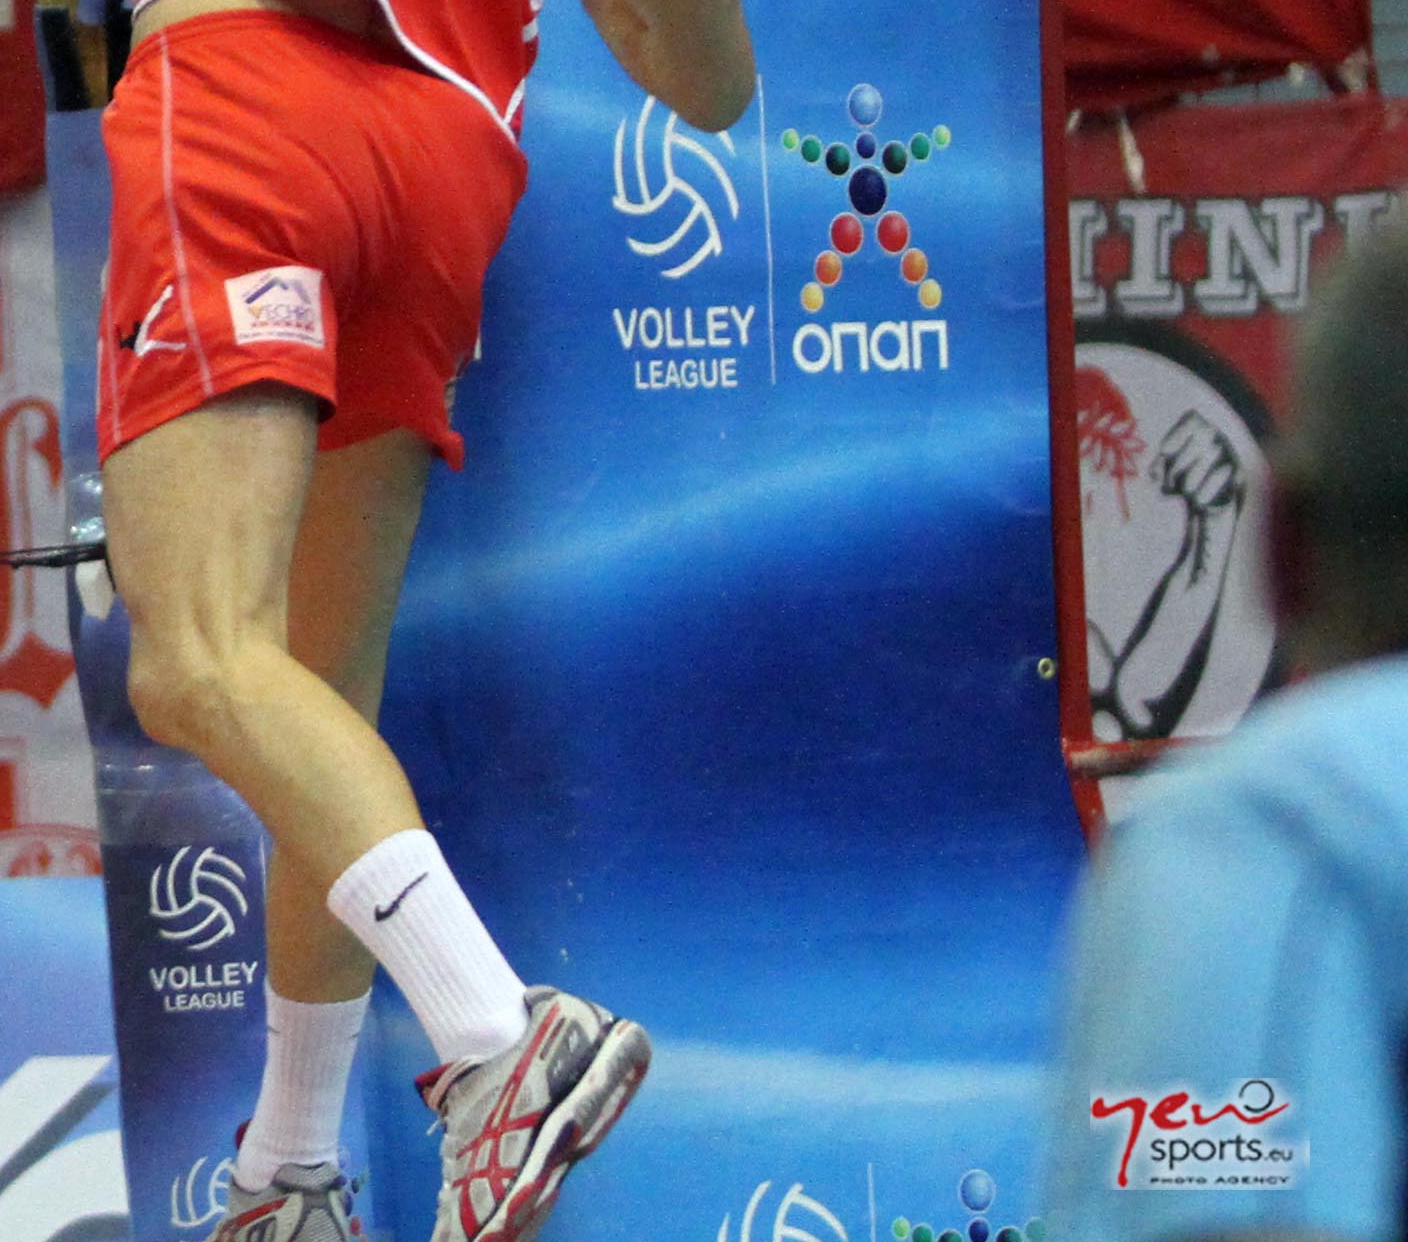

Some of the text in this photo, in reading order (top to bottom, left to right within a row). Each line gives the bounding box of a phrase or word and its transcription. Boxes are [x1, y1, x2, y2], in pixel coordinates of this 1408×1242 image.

[612, 305, 755, 350] VOLLEY
[634, 358, 738, 390] LEAGUE
[149, 961, 258, 991] VOLLEY
[164, 990, 245, 1012] LEAGUE
